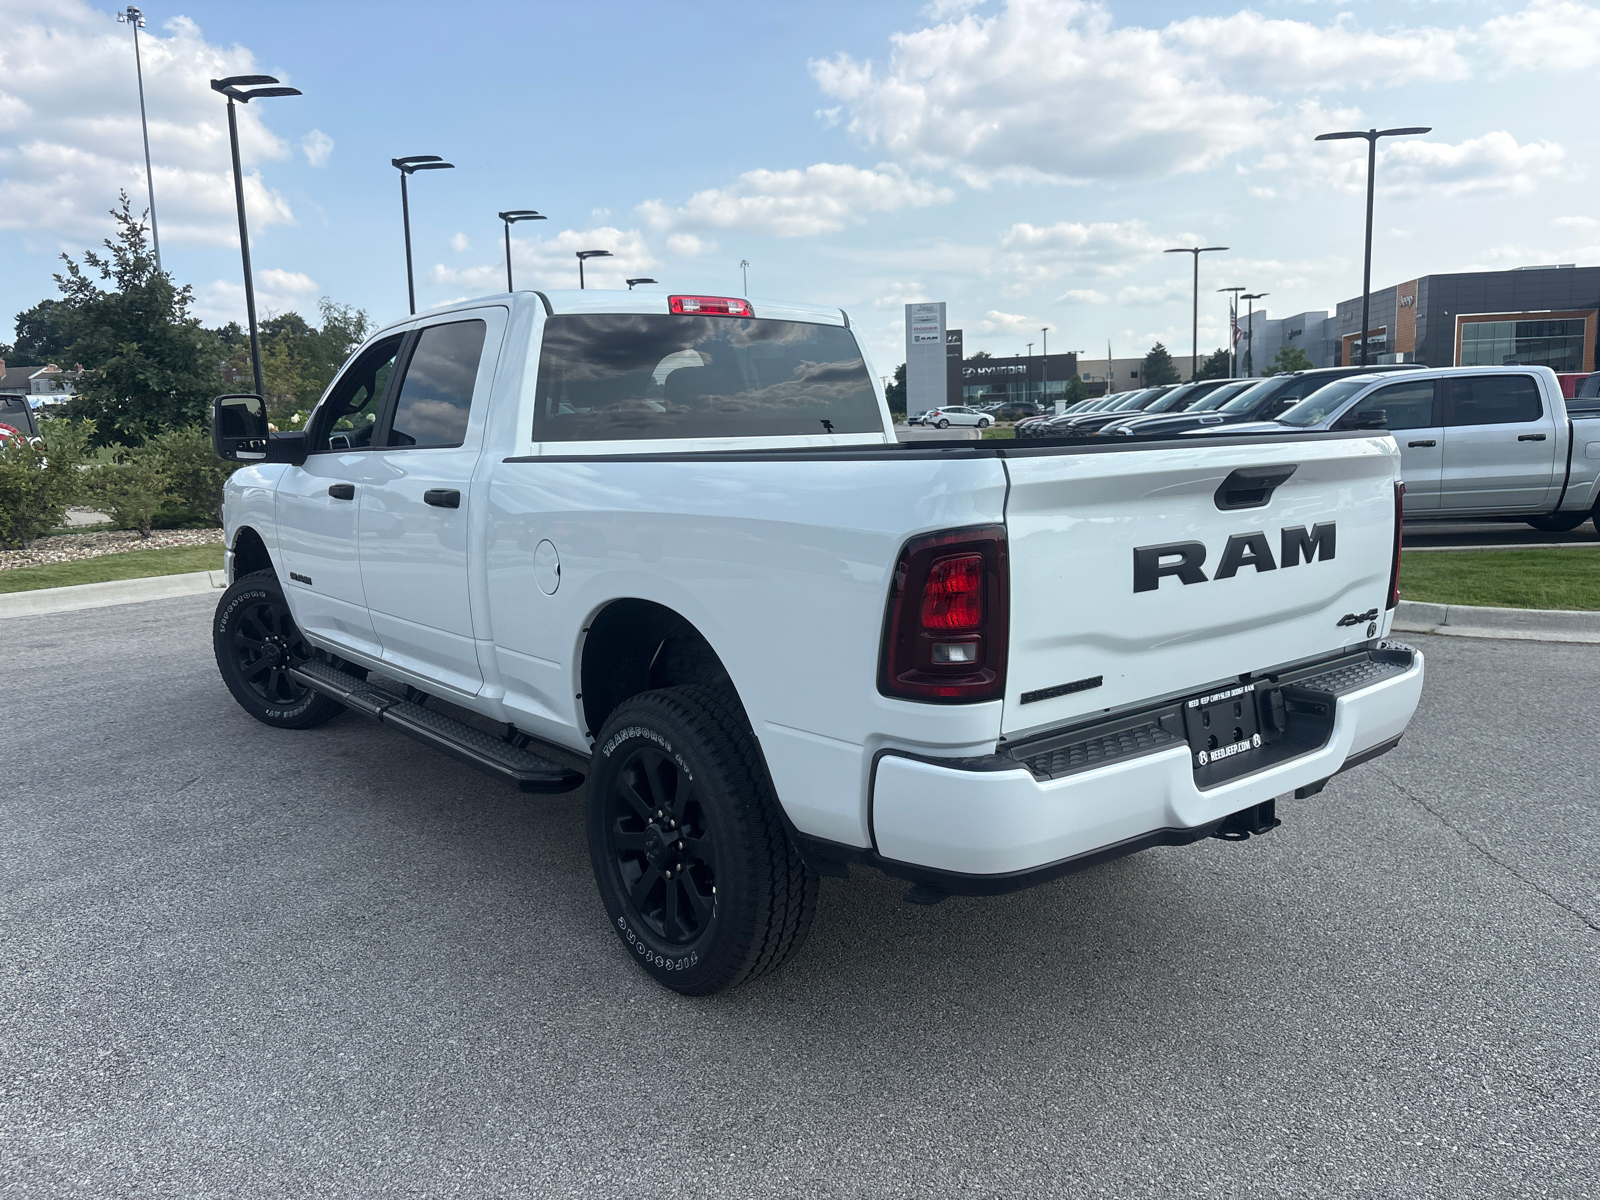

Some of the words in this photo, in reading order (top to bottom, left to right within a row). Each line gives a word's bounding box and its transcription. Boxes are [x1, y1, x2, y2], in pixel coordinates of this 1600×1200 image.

[916, 304, 934, 313] Jeep
[977, 364, 1027, 376] HYUNDAI
[1132, 520, 1337, 594] RAM
[1188, 699, 1200, 708] REED
[1200, 696, 1210, 705] JEEP
[1210, 690, 1231, 702] CHRYSLER
[1231, 686, 1244, 697] DODGE
[1244, 683, 1255, 693] RAM
[602, 726, 672, 758] TRANSFORCE
[1210, 740, 1251, 762] REEDJEEP.COM
